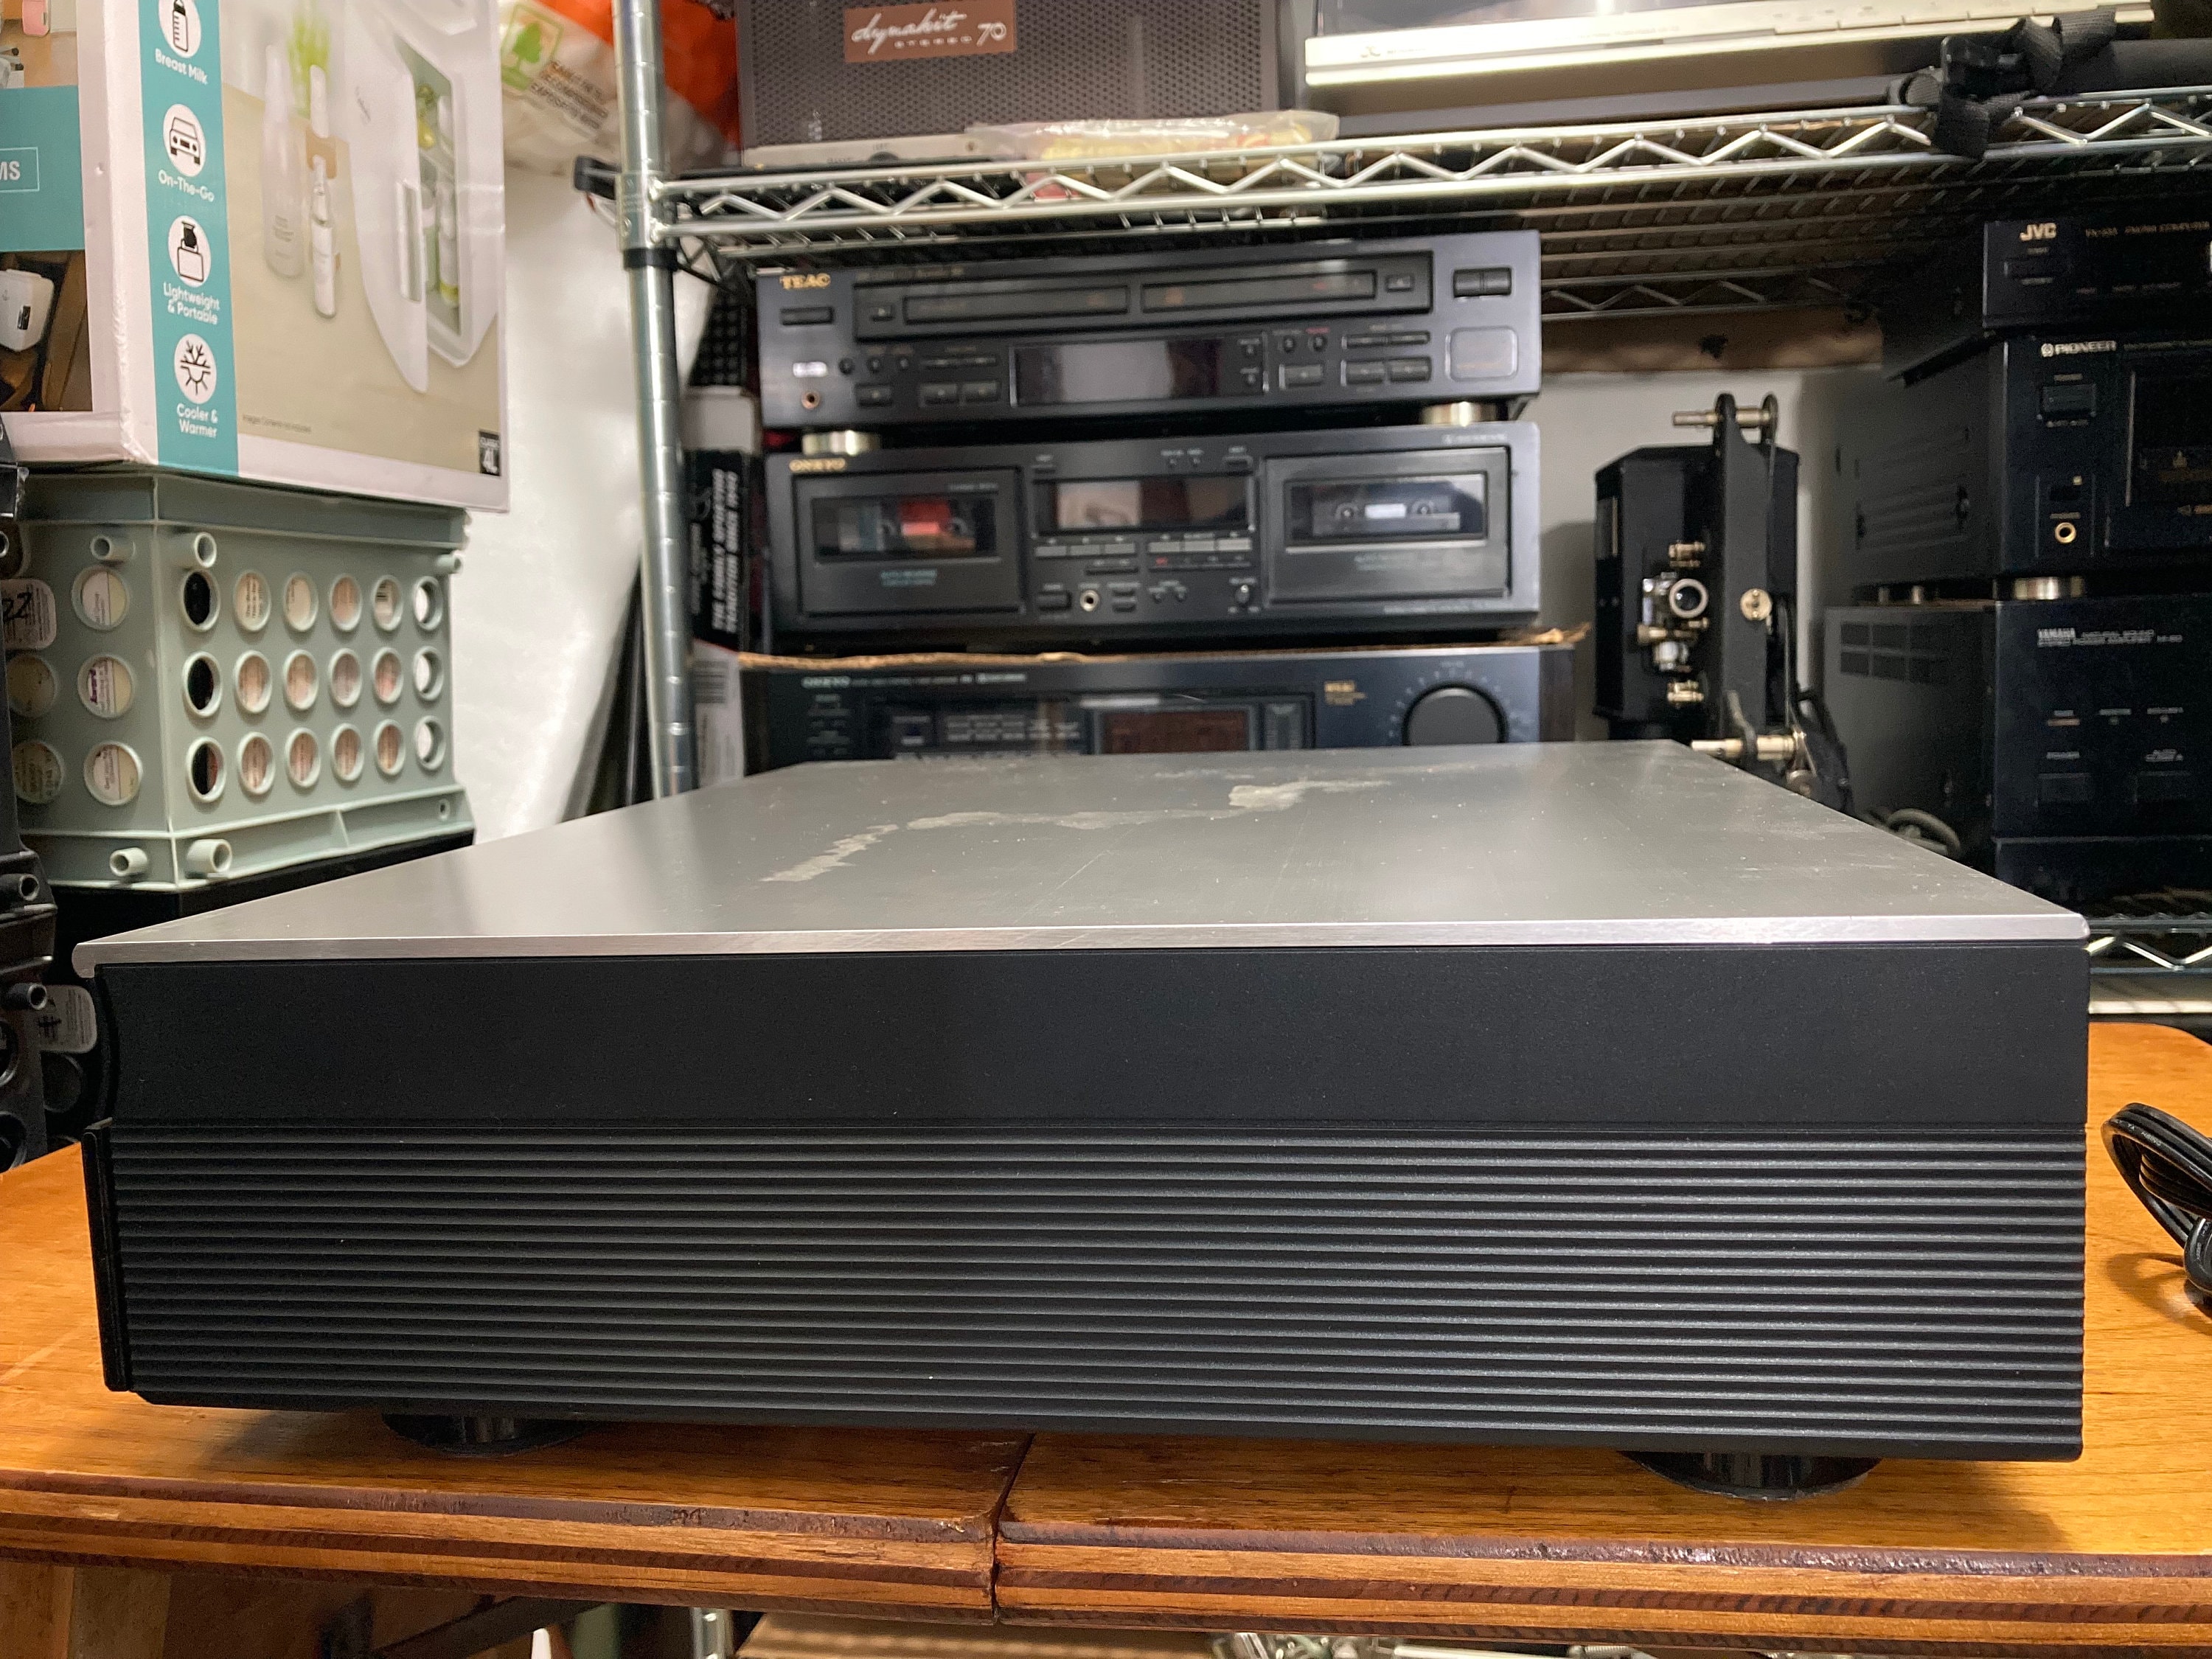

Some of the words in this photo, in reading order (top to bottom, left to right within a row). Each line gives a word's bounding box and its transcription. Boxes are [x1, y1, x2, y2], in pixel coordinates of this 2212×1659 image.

[851, 7, 968, 55] dynakit
[977, 21, 1007, 47] 70
[155, 47, 187, 75] Breast
[188, 63, 209, 86] Milk
[158, 169, 215, 203] On-The-Go
[2019, 221, 2057, 242] JVC
[779, 272, 832, 290] TEAC
[163, 281, 220, 311] Lightweight
[176, 300, 218, 325] Portable
[2055, 339, 2117, 355] PIONEER
[177, 403, 209, 422] Cooler
[210, 408, 219, 424] &
[178, 417, 218, 439] Warmer
